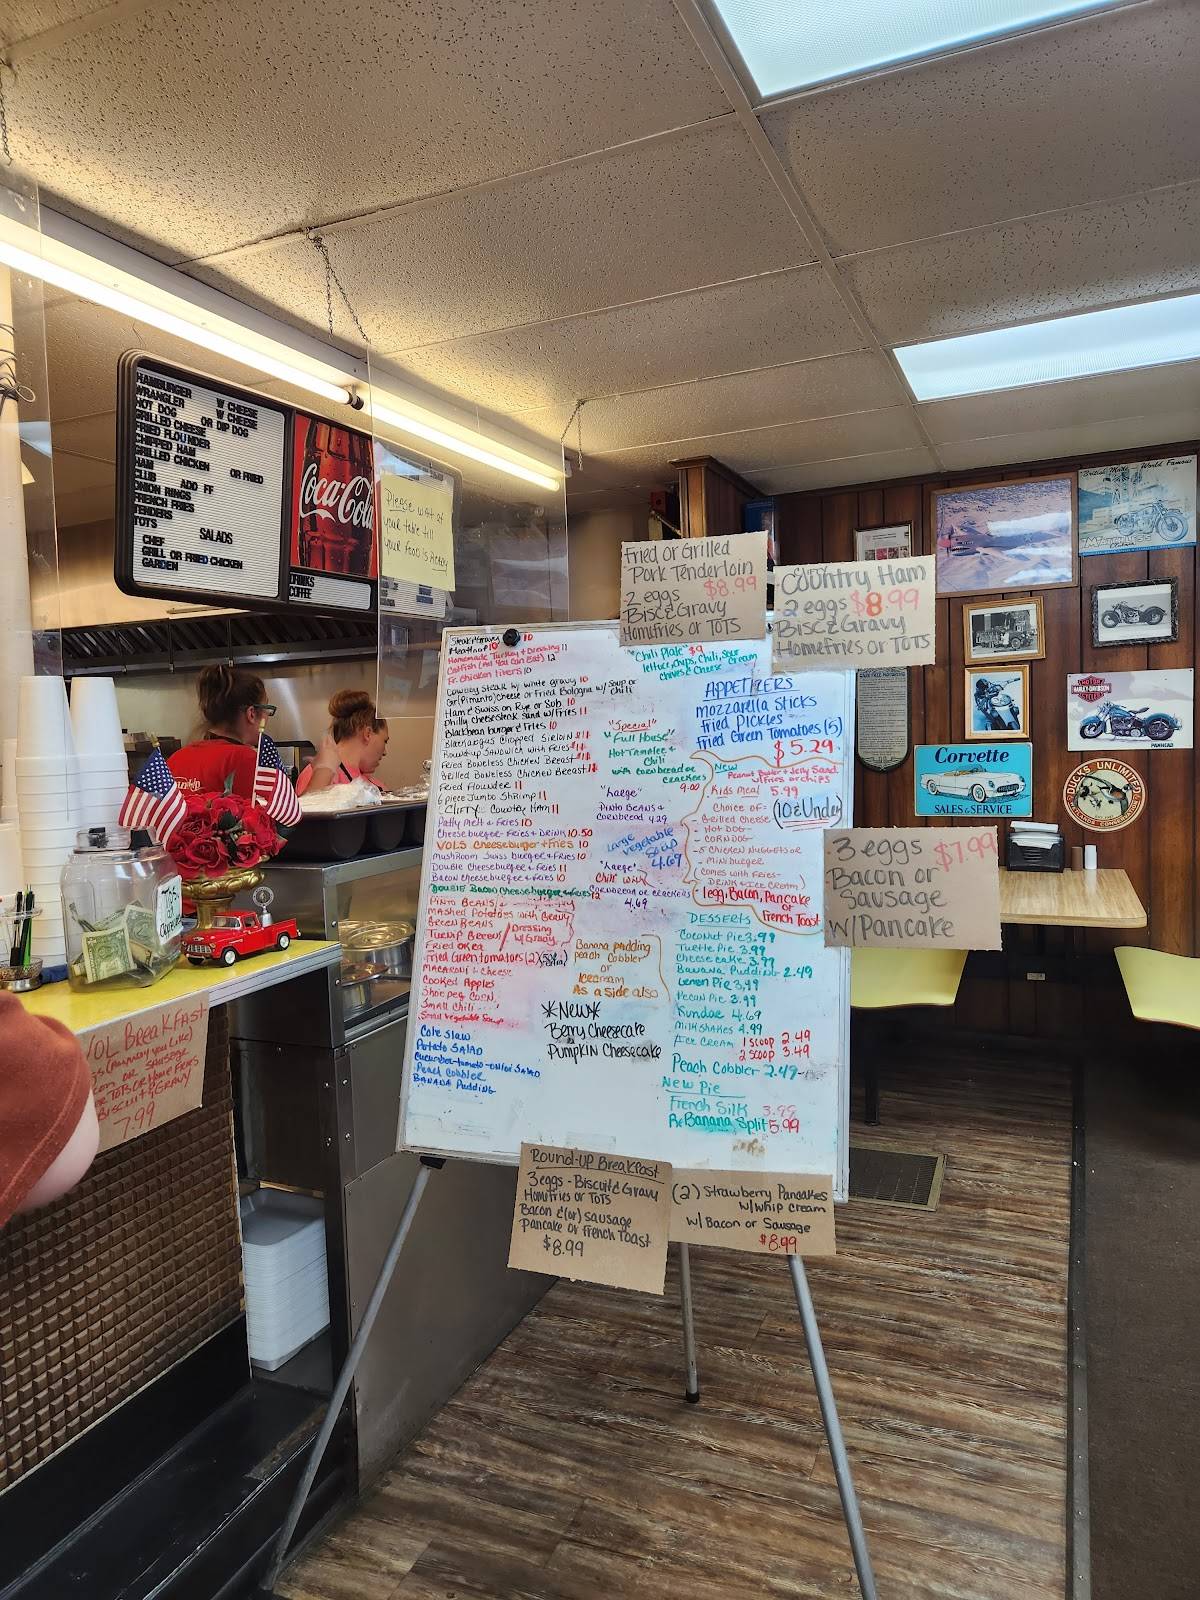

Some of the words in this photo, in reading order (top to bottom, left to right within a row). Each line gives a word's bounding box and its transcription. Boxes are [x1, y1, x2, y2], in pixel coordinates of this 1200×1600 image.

[137, 372, 192, 399] HAMBURGER
[137, 384, 184, 408] WRANGLER
[136, 397, 154, 410] HOT
[158, 404, 177, 417] DOG
[228, 402, 258, 419] CHEESE
[136, 409, 171, 428] GRILLED
[174, 420, 206, 437] CHEESE
[201, 416, 213, 428] OR
[217, 421, 229, 432] DIP
[232, 425, 249, 438] DOG
[227, 413, 258, 430] CHEESE
[136, 421, 160, 437] FRIED
[164, 428, 210, 449] FLOUNDER
[136, 433, 172, 451] CHIPPED
[177, 444, 196, 457] HAM
[135, 457, 154, 470] HAM
[136, 445, 170, 462] GRILLED
[174, 455, 210, 472] CHICKEN
[1140, 461, 1163, 469] World
[135, 469, 156, 482] CLUB
[181, 479, 198, 491] ADD
[204, 484, 214, 494] FF
[230, 468, 241, 481] OR
[243, 472, 264, 484] FRIED
[135, 480, 160, 495] ONION
[165, 487, 191, 501] RINGS
[300, 463, 373, 530] Coca-Cola
[134, 504, 173, 520] TENDERS
[135, 492, 167, 507] FRENCH
[171, 500, 194, 513] FRIES
[135, 516, 157, 528] TOTS
[143, 534, 165, 547] CHEF
[200, 528, 233, 544] SALADS
[142, 546, 166, 559] GRILL
[170, 550, 182, 561] OR
[185, 552, 208, 565] FRIED
[210, 556, 243, 570] CHICKEN
[624, 546, 658, 564] Fried
[682, 540, 730, 559] Grilled
[142, 558, 178, 571] GARDEN
[628, 566, 667, 584] Pork
[671, 560, 753, 582] Tenderloin
[290, 574, 315, 588] DRINKS
[878, 564, 926, 586] Ham
[289, 586, 312, 599] COFFEE
[626, 592, 641, 606] 2
[644, 589, 680, 608] eggs
[704, 575, 757, 600] $8.99
[784, 600, 798, 616] 2
[803, 599, 848, 621] eggs
[850, 588, 919, 617] $8.99
[689, 622, 702, 635] or
[705, 677, 793, 698] APPETIZERS
[731, 730, 763, 742] Green
[768, 723, 821, 740] Tomatoes
[824, 717, 843, 737] (5)
[935, 747, 1010, 764] Corvette
[1067, 765, 1091, 794] DUCKS
[1097, 762, 1141, 794] UNLIMITED
[770, 786, 799, 798] 5.99
[934, 804, 962, 814] SALES
[971, 804, 1012, 814] SERVICE
[568, 828, 593, 837] 10.50
[832, 836, 856, 862] 3
[861, 839, 923, 866] eggs
[934, 832, 997, 872] $7.99
[826, 867, 905, 890] Bacon
[914, 867, 940, 883] or
[840, 888, 948, 914] Sausage
[796, 914, 821, 927] Toast
[784, 966, 813, 978] 2.49
[632, 987, 658, 998] also
[544, 1022, 586, 1040] Berry
[588, 1022, 645, 1039] Cheesecake
[782, 1030, 810, 1044] 2.49
[603, 1043, 661, 1059] Cheesecake
[782, 1044, 810, 1058] 3.49
[672, 1053, 707, 1073] Peach
[713, 1061, 760, 1076] Cobbler
[700, 1081, 720, 1094] Pie
[113, 1100, 155, 1139] 7.99
[735, 1117, 768, 1135] Split
[769, 1119, 799, 1134] 5.99
[574, 1191, 585, 1200] or
[622, 1183, 659, 1202] Gravy
[672, 1183, 700, 1205] (2)
[703, 1185, 772, 1203] Strawberry
[519, 1203, 552, 1217] Bacon
[705, 1216, 741, 1229] Bacon
[746, 1219, 757, 1228] or
[764, 1217, 811, 1234] Sausage
[568, 1224, 579, 1234] or
[618, 1229, 652, 1248] Toast
[759, 1233, 797, 1253] $8.99
[543, 1235, 584, 1257] $8.99
